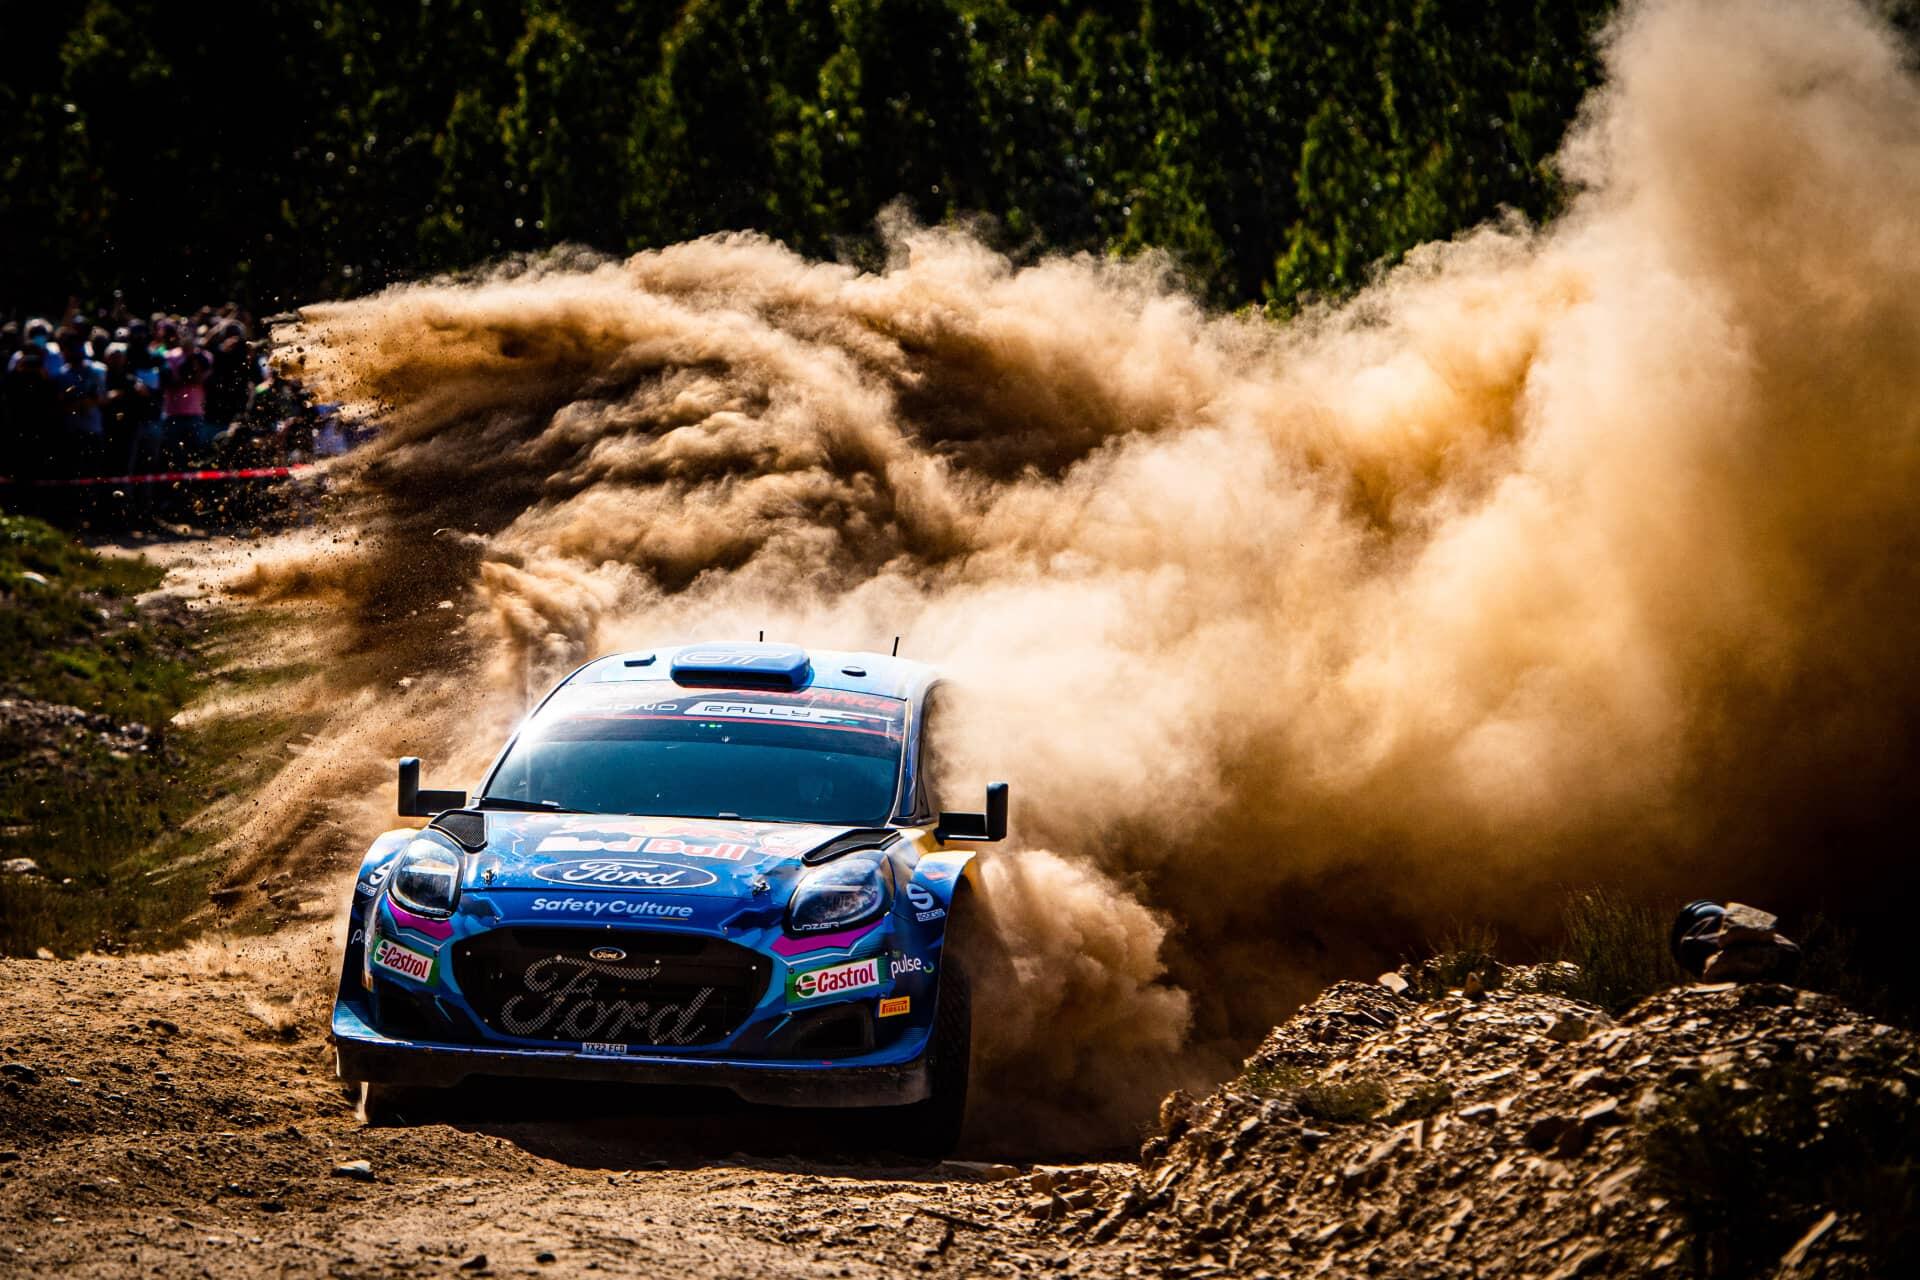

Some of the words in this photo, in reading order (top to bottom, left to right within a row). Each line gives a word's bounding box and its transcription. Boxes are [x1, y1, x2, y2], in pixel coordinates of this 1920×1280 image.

[704, 704, 811, 718] RALLY
[643, 838, 749, 861] Bull
[562, 862, 684, 886] Ford
[531, 898, 694, 917] SafetyCulture
[383, 946, 428, 979] Castrol
[890, 954, 922, 979] pulse
[817, 963, 876, 993] Castrol
[501, 957, 715, 1045] Ford
